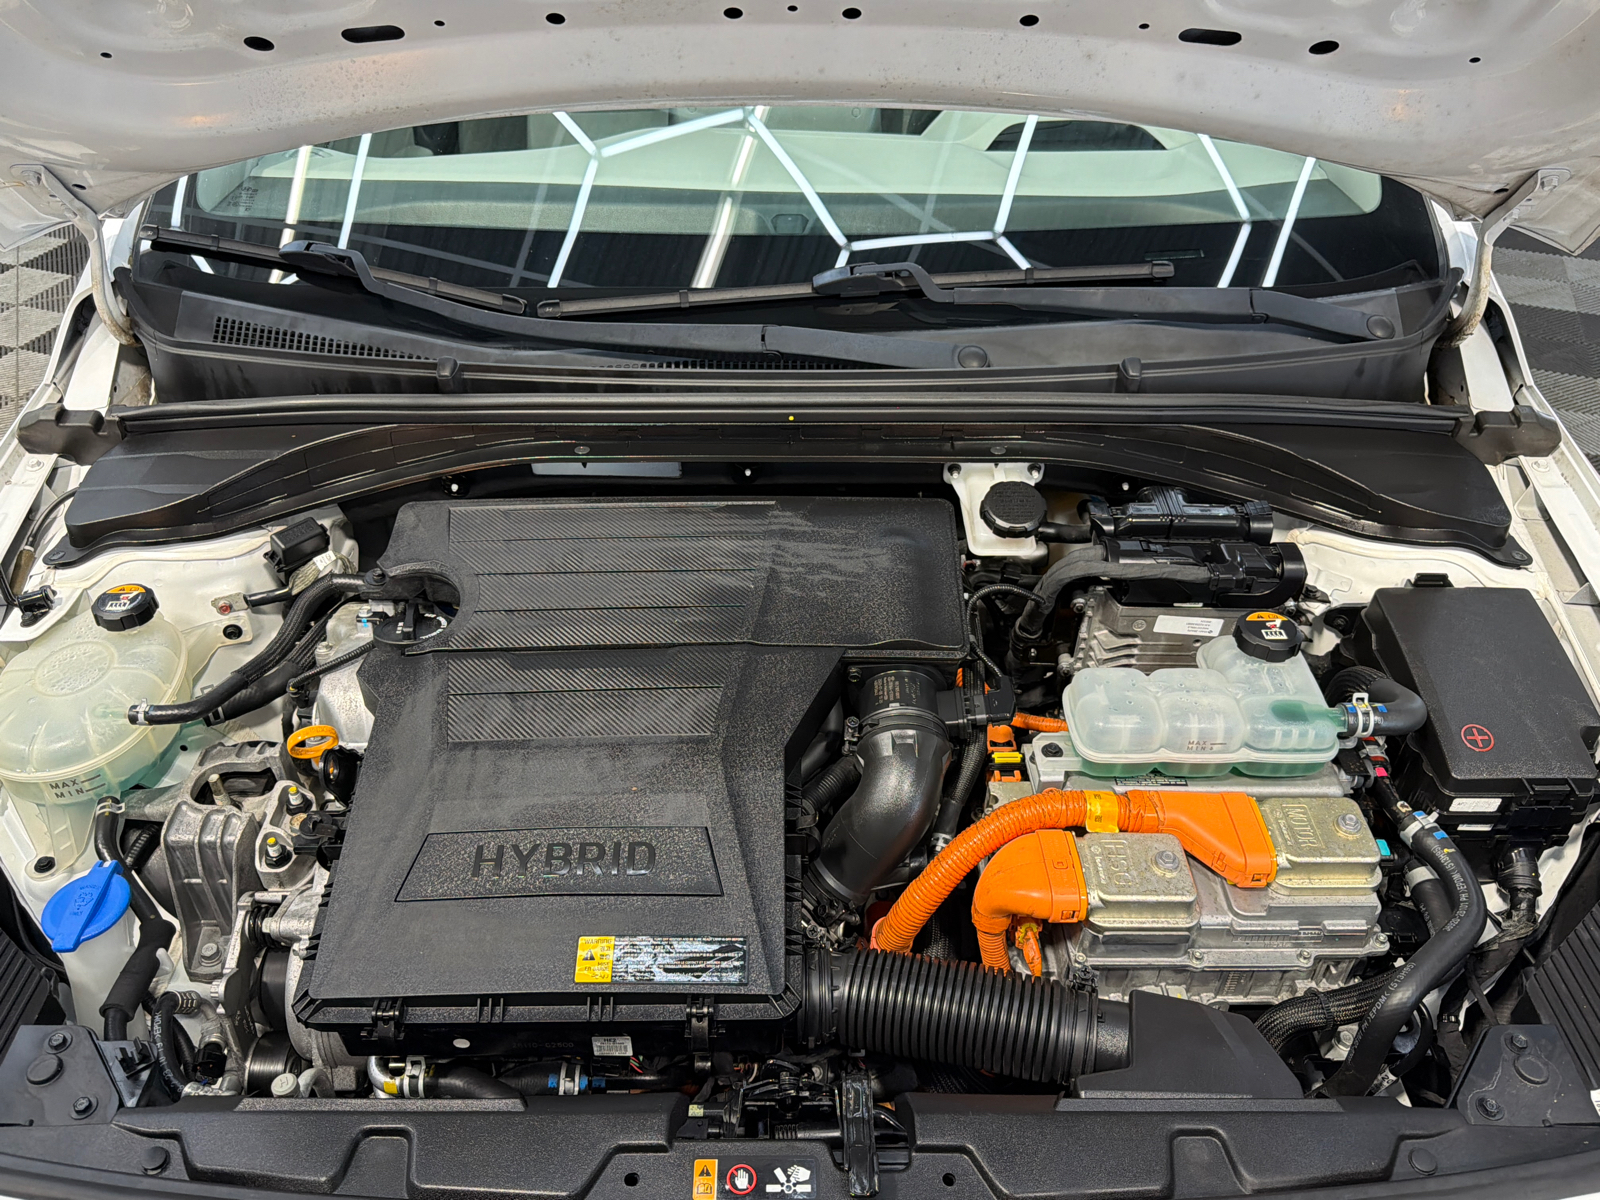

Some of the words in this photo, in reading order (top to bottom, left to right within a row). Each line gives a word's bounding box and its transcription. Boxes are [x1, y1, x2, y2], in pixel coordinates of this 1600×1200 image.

[49, 778, 79, 790] MAX
[54, 787, 85, 799] MIN
[1285, 808, 1319, 847] MOTOR
[471, 841, 656, 879] HYBRID
